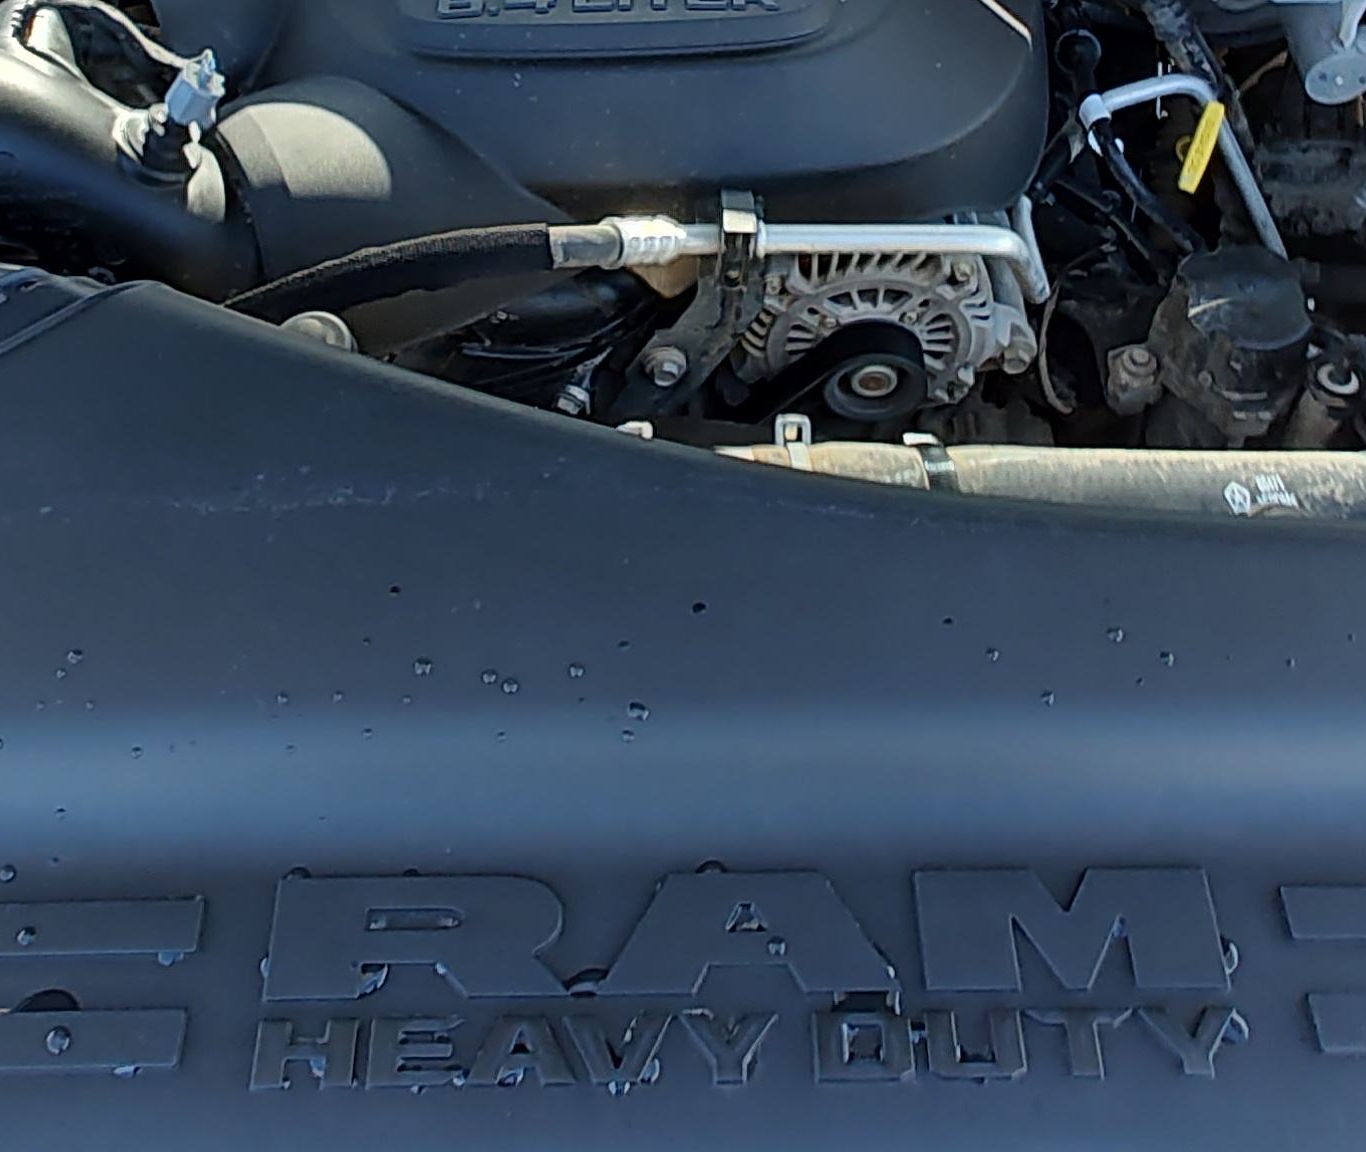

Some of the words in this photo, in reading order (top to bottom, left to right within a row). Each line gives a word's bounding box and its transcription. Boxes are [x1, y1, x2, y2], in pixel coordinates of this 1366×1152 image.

[259, 866, 1232, 1002] RAM
[248, 1011, 779, 1091] HEAVY
[812, 1006, 1239, 1084] DUTY
